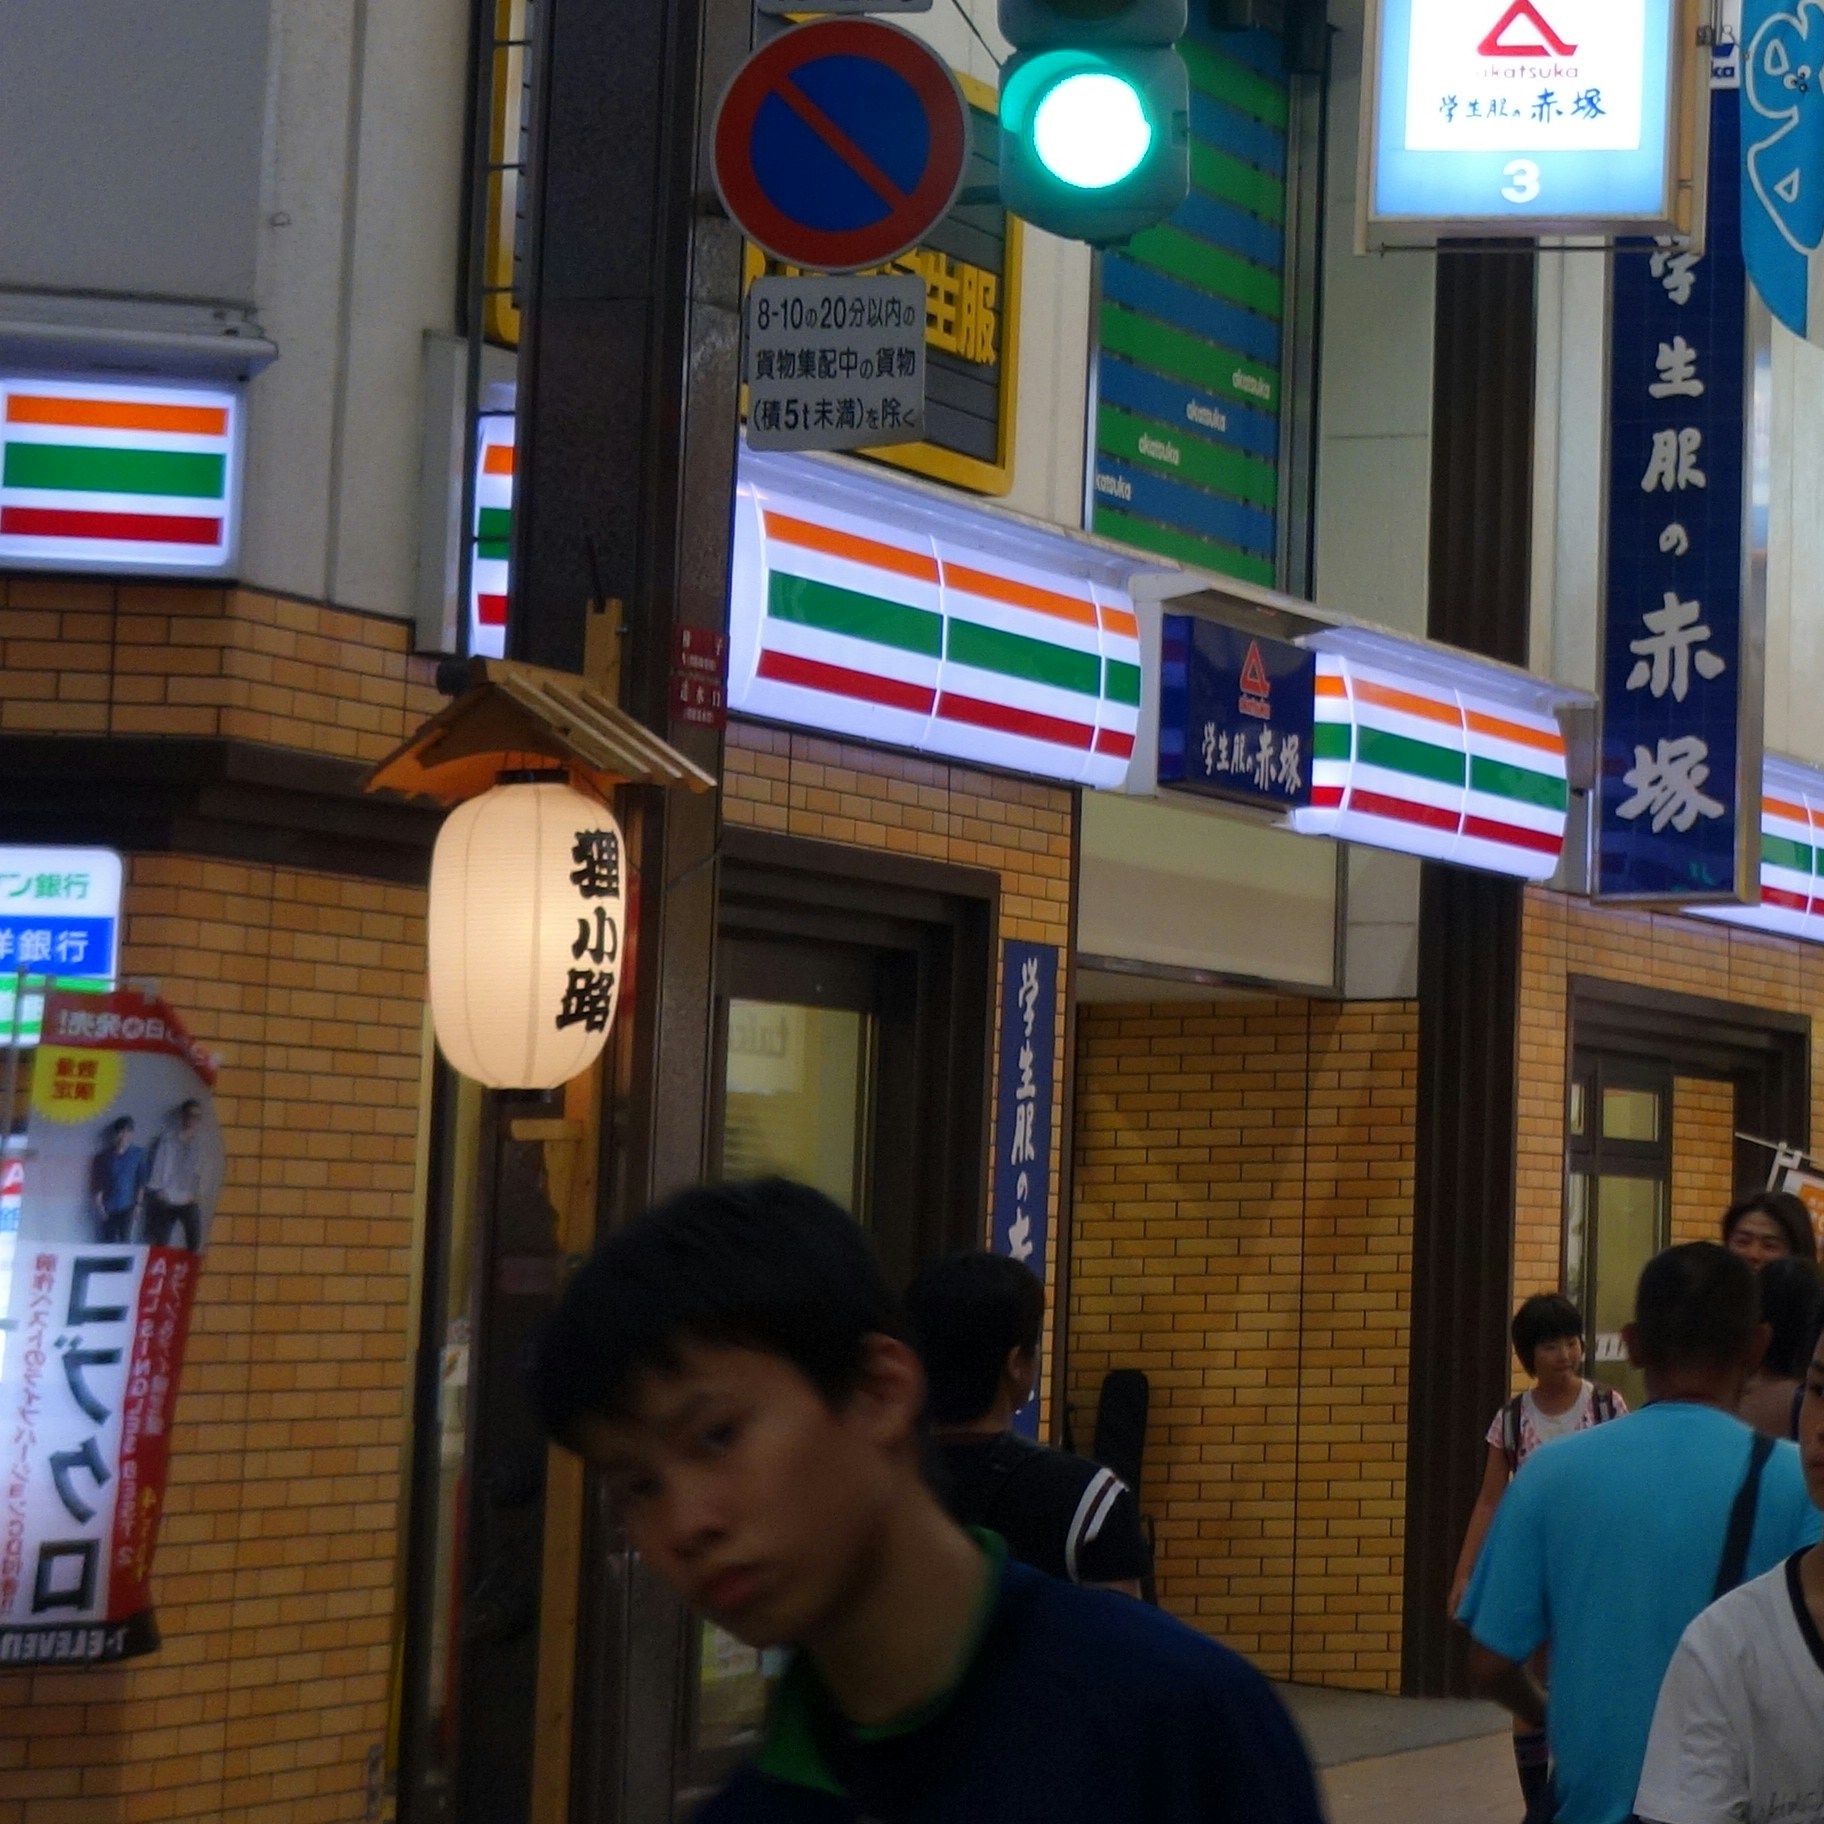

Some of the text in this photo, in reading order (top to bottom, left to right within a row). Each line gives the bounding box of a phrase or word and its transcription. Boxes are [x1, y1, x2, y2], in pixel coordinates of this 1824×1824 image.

[1438, 87, 1607, 124] 学生服の赤塚
[1500, 158, 1541, 204] 3
[888, 246, 996, 366] 生服
[755, 346, 916, 381] 貨物集配中の貨物
[1622, 234, 1726, 837] 学生服の赤塚
[1201, 721, 1302, 797] 学生服の赤塚
[0, 872, 91, 901] ン銀行
[554, 828, 620, 1034] 狸小路
